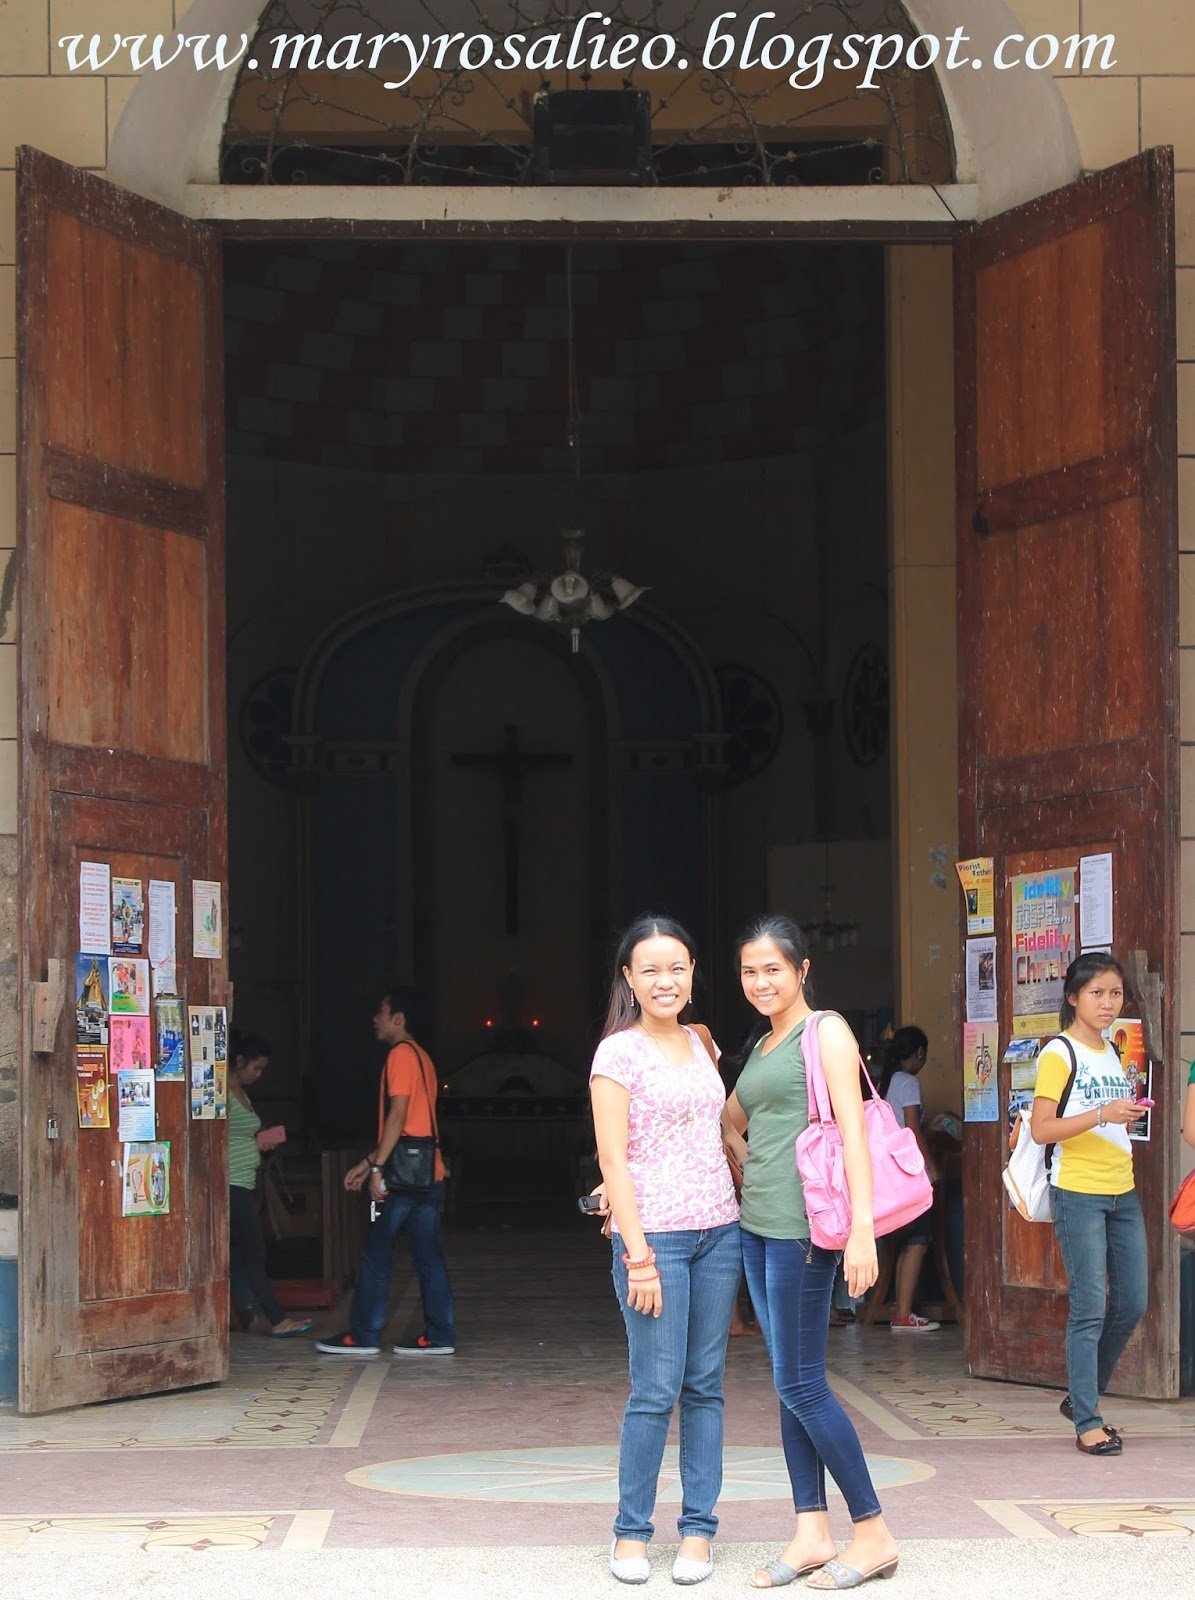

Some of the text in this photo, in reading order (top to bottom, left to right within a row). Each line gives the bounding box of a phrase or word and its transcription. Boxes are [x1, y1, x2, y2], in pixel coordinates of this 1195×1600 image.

[1015, 875, 1071, 902] Fidelity
[1015, 928, 1071, 953] Fidelity
[1075, 1075, 1130, 1090] LA SALL
